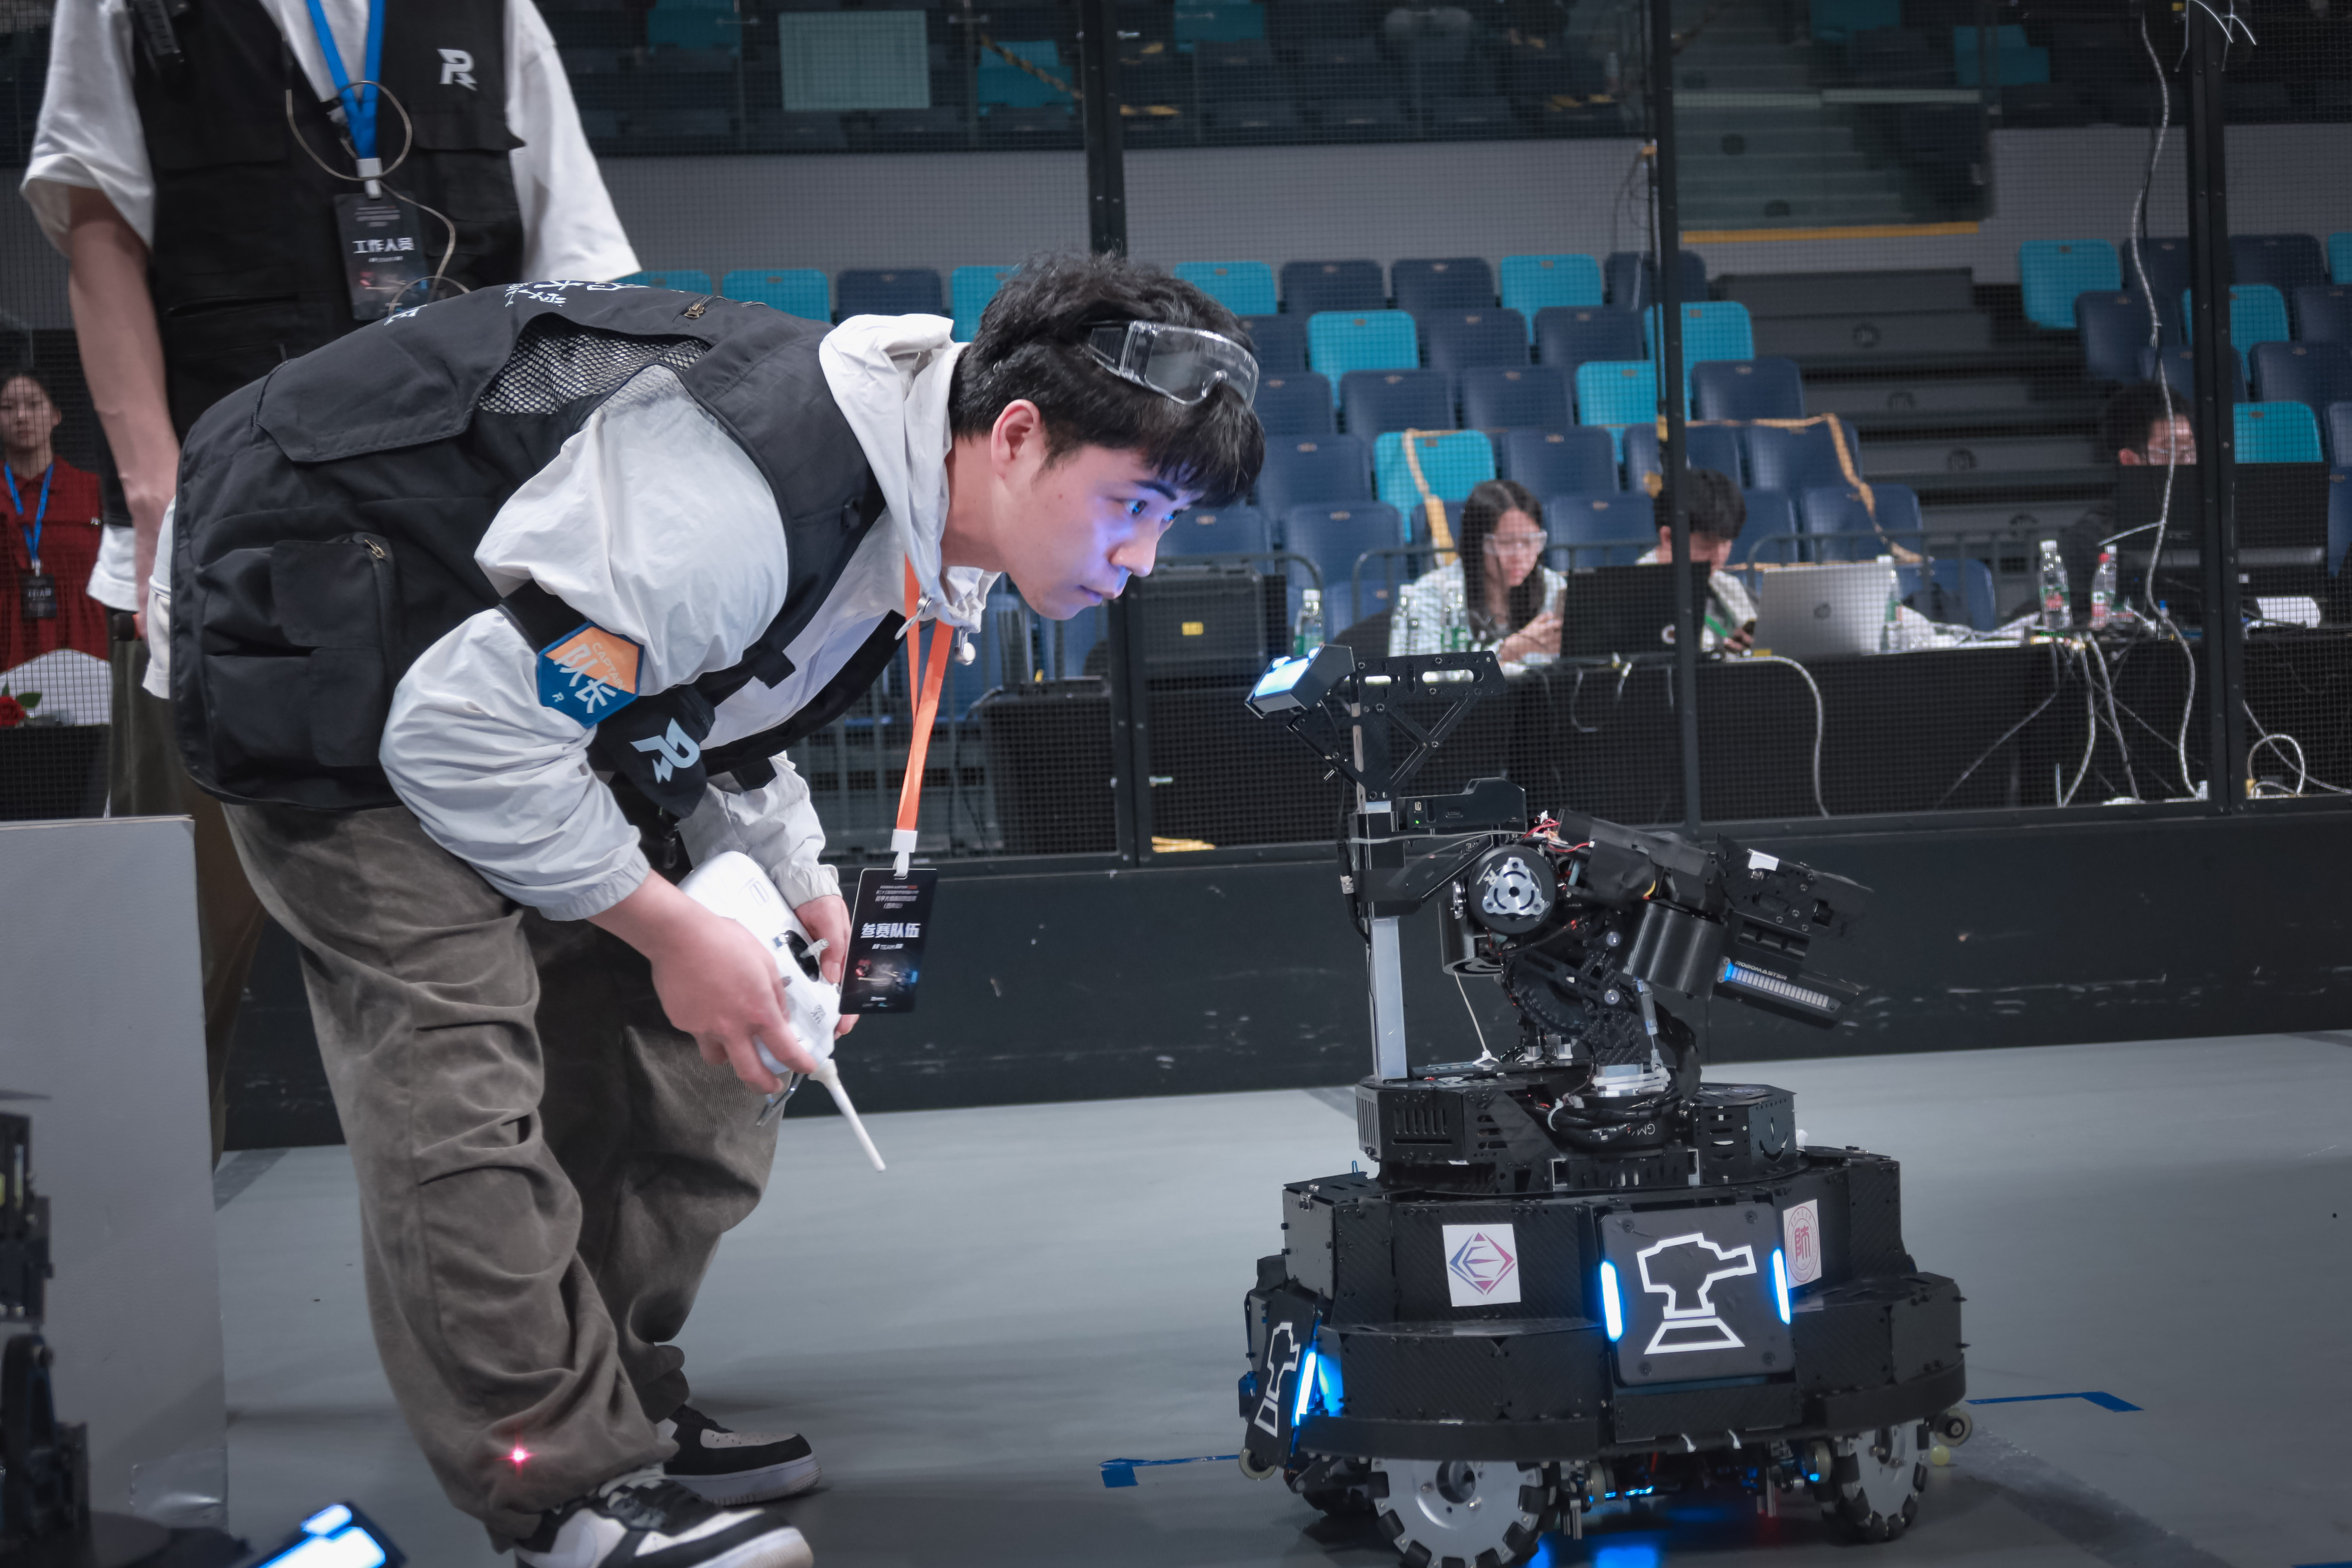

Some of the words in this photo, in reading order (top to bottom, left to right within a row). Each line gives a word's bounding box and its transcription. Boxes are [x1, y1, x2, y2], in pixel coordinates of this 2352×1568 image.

[352, 237, 415, 254] 工作人员
[593, 642, 626, 690] CAPTAIN
[553, 643, 616, 714] 队长
[860, 923, 921, 938] 参赛队伍
[1735, 961, 1787, 980] ROBOMASTER
